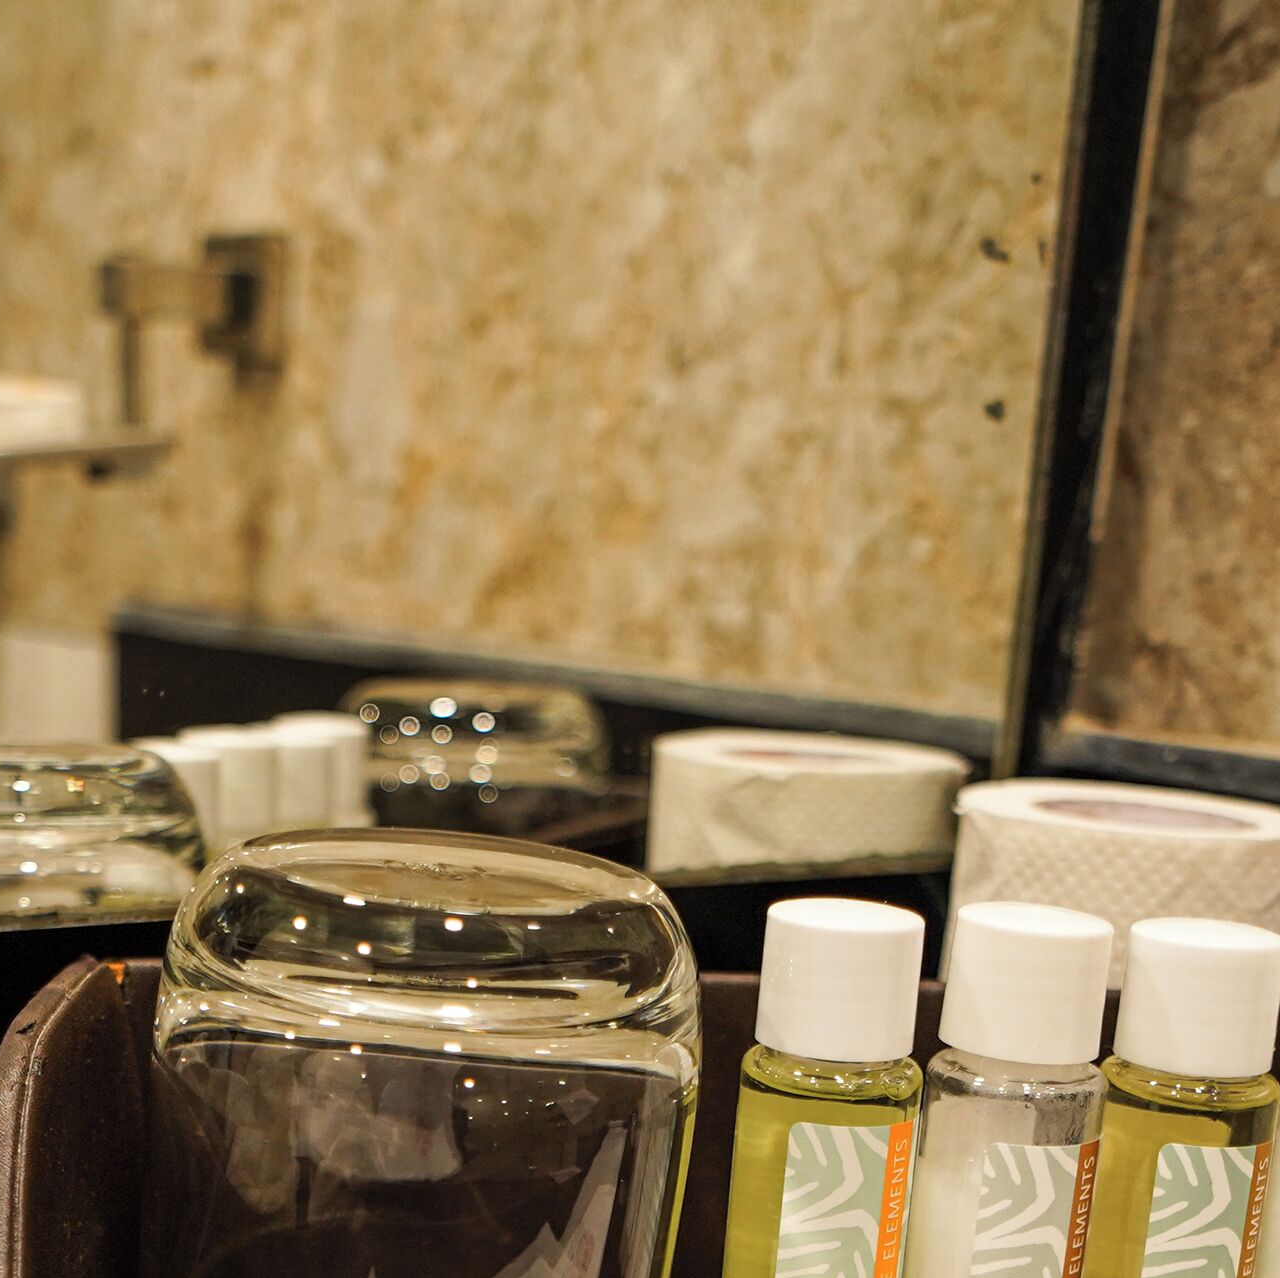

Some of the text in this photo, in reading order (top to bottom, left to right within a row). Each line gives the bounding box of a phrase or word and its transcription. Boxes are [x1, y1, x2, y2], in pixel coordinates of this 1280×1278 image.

[883, 1138, 908, 1260] ELEMENTS
[1069, 1156, 1095, 1275] ELEMENTS
[1243, 1157, 1269, 1277] ELEMENTS
